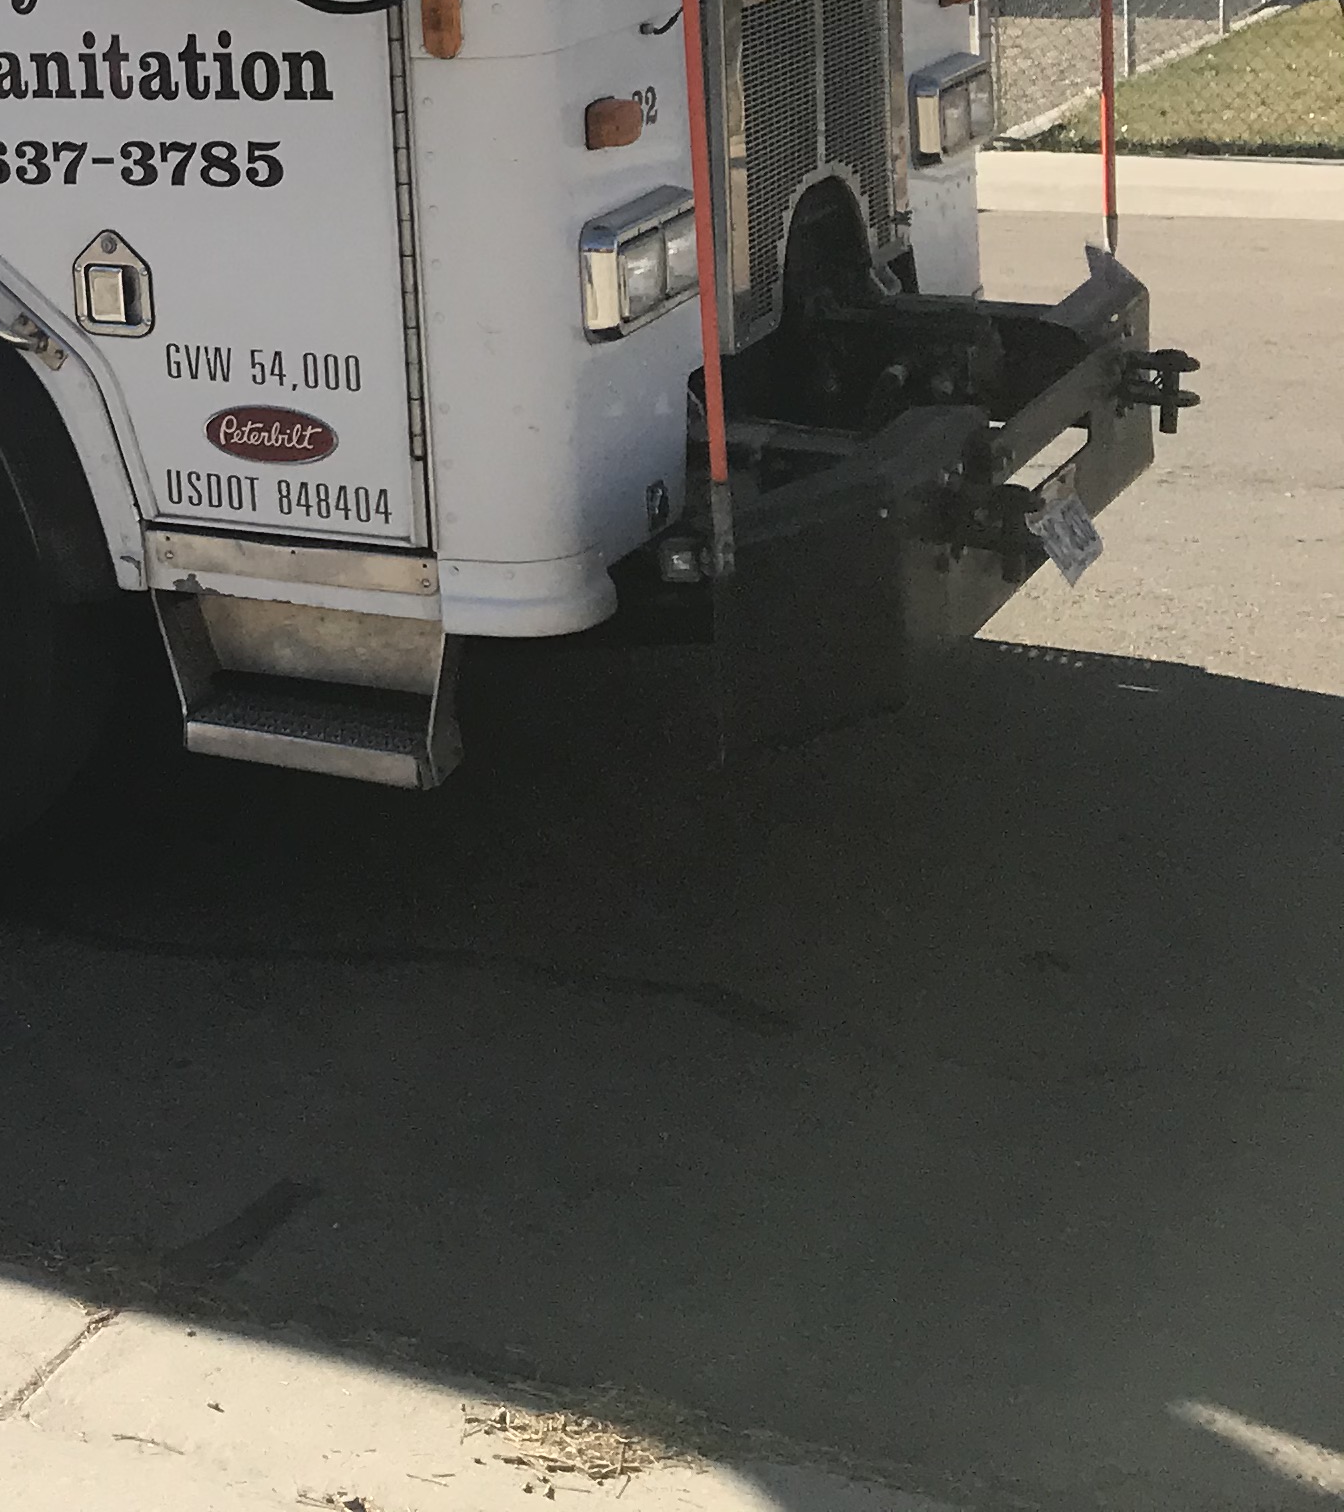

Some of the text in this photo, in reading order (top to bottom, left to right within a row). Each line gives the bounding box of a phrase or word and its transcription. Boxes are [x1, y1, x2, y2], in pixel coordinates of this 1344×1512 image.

[165, 342, 362, 393] GVW 54,000
[219, 414, 323, 449] Peterbilt
[166, 468, 393, 525] USDOT 848404
